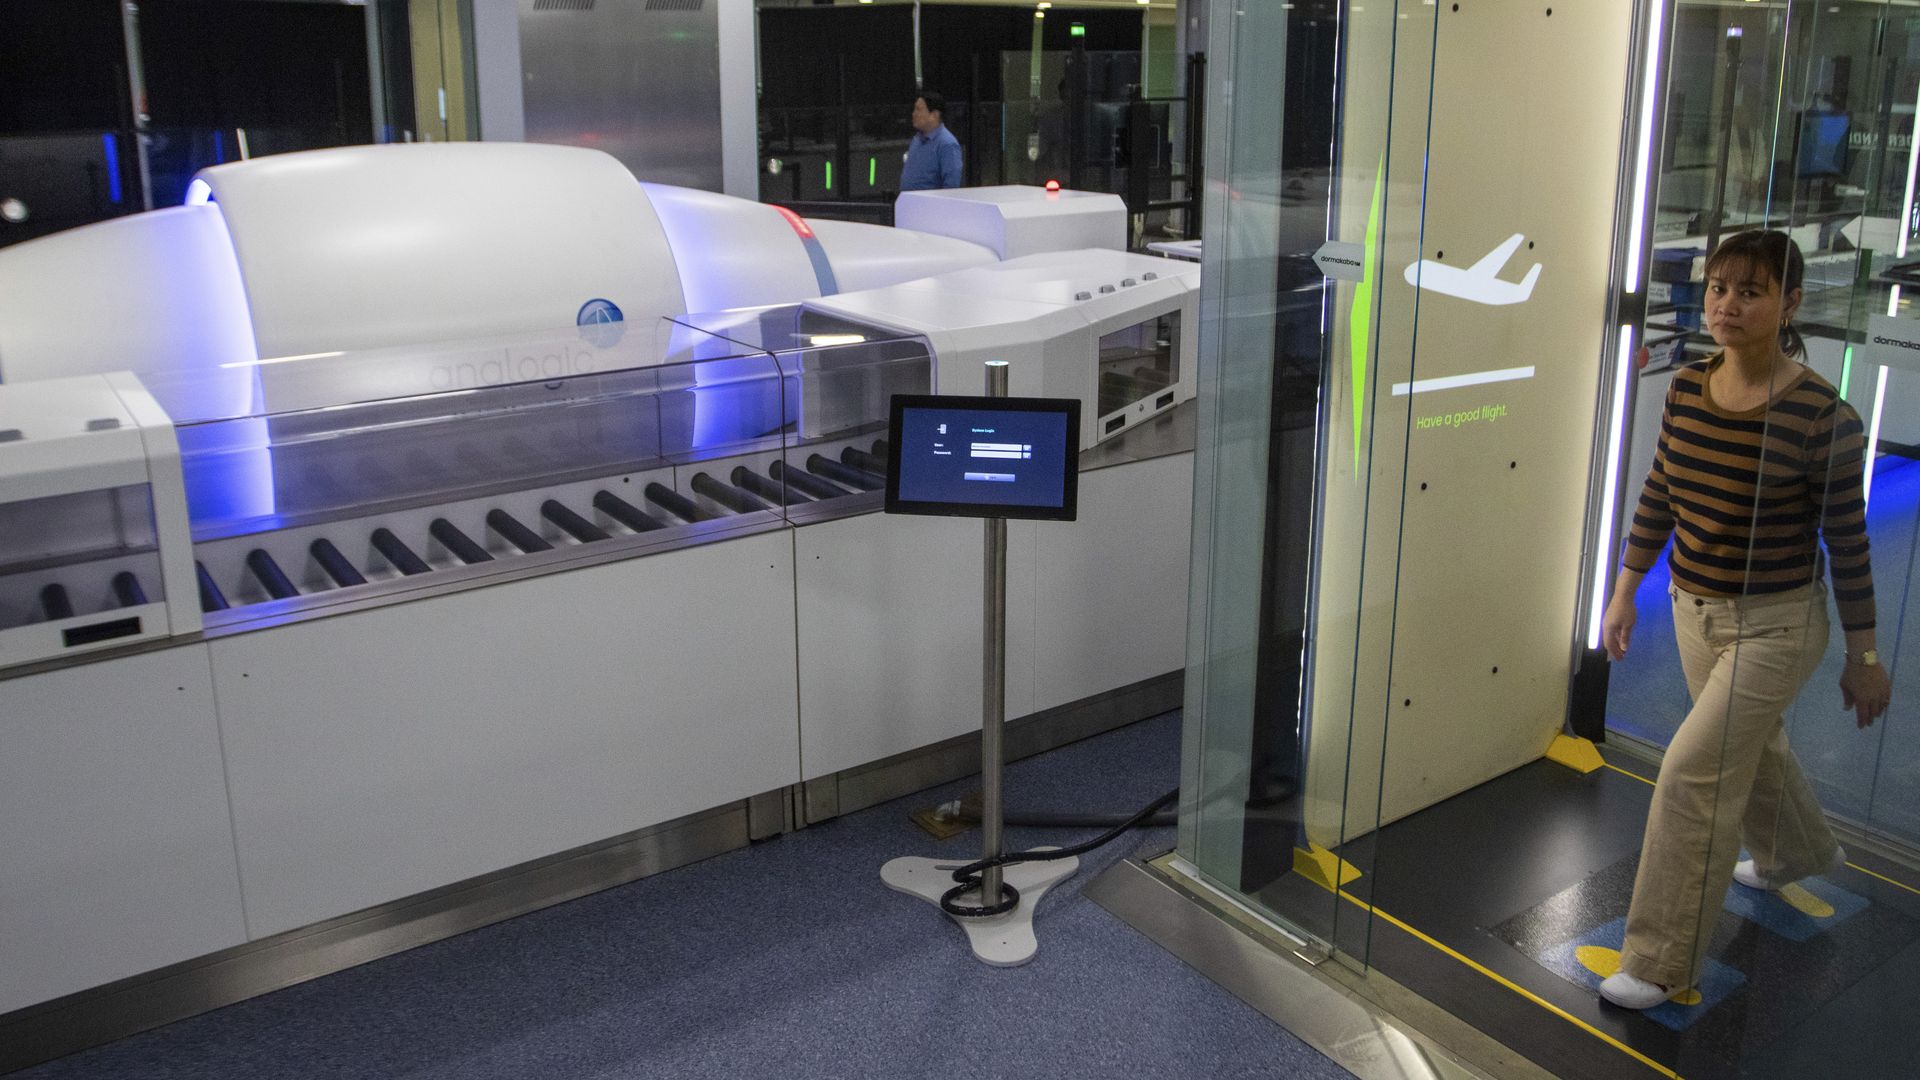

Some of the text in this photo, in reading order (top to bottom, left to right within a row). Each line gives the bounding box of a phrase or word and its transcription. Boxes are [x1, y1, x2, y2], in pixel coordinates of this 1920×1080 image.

[1320, 256, 1355, 266] dormakaba
[429, 345, 594, 391] analogic
[1416, 403, 1508, 429] Have a good flight.
